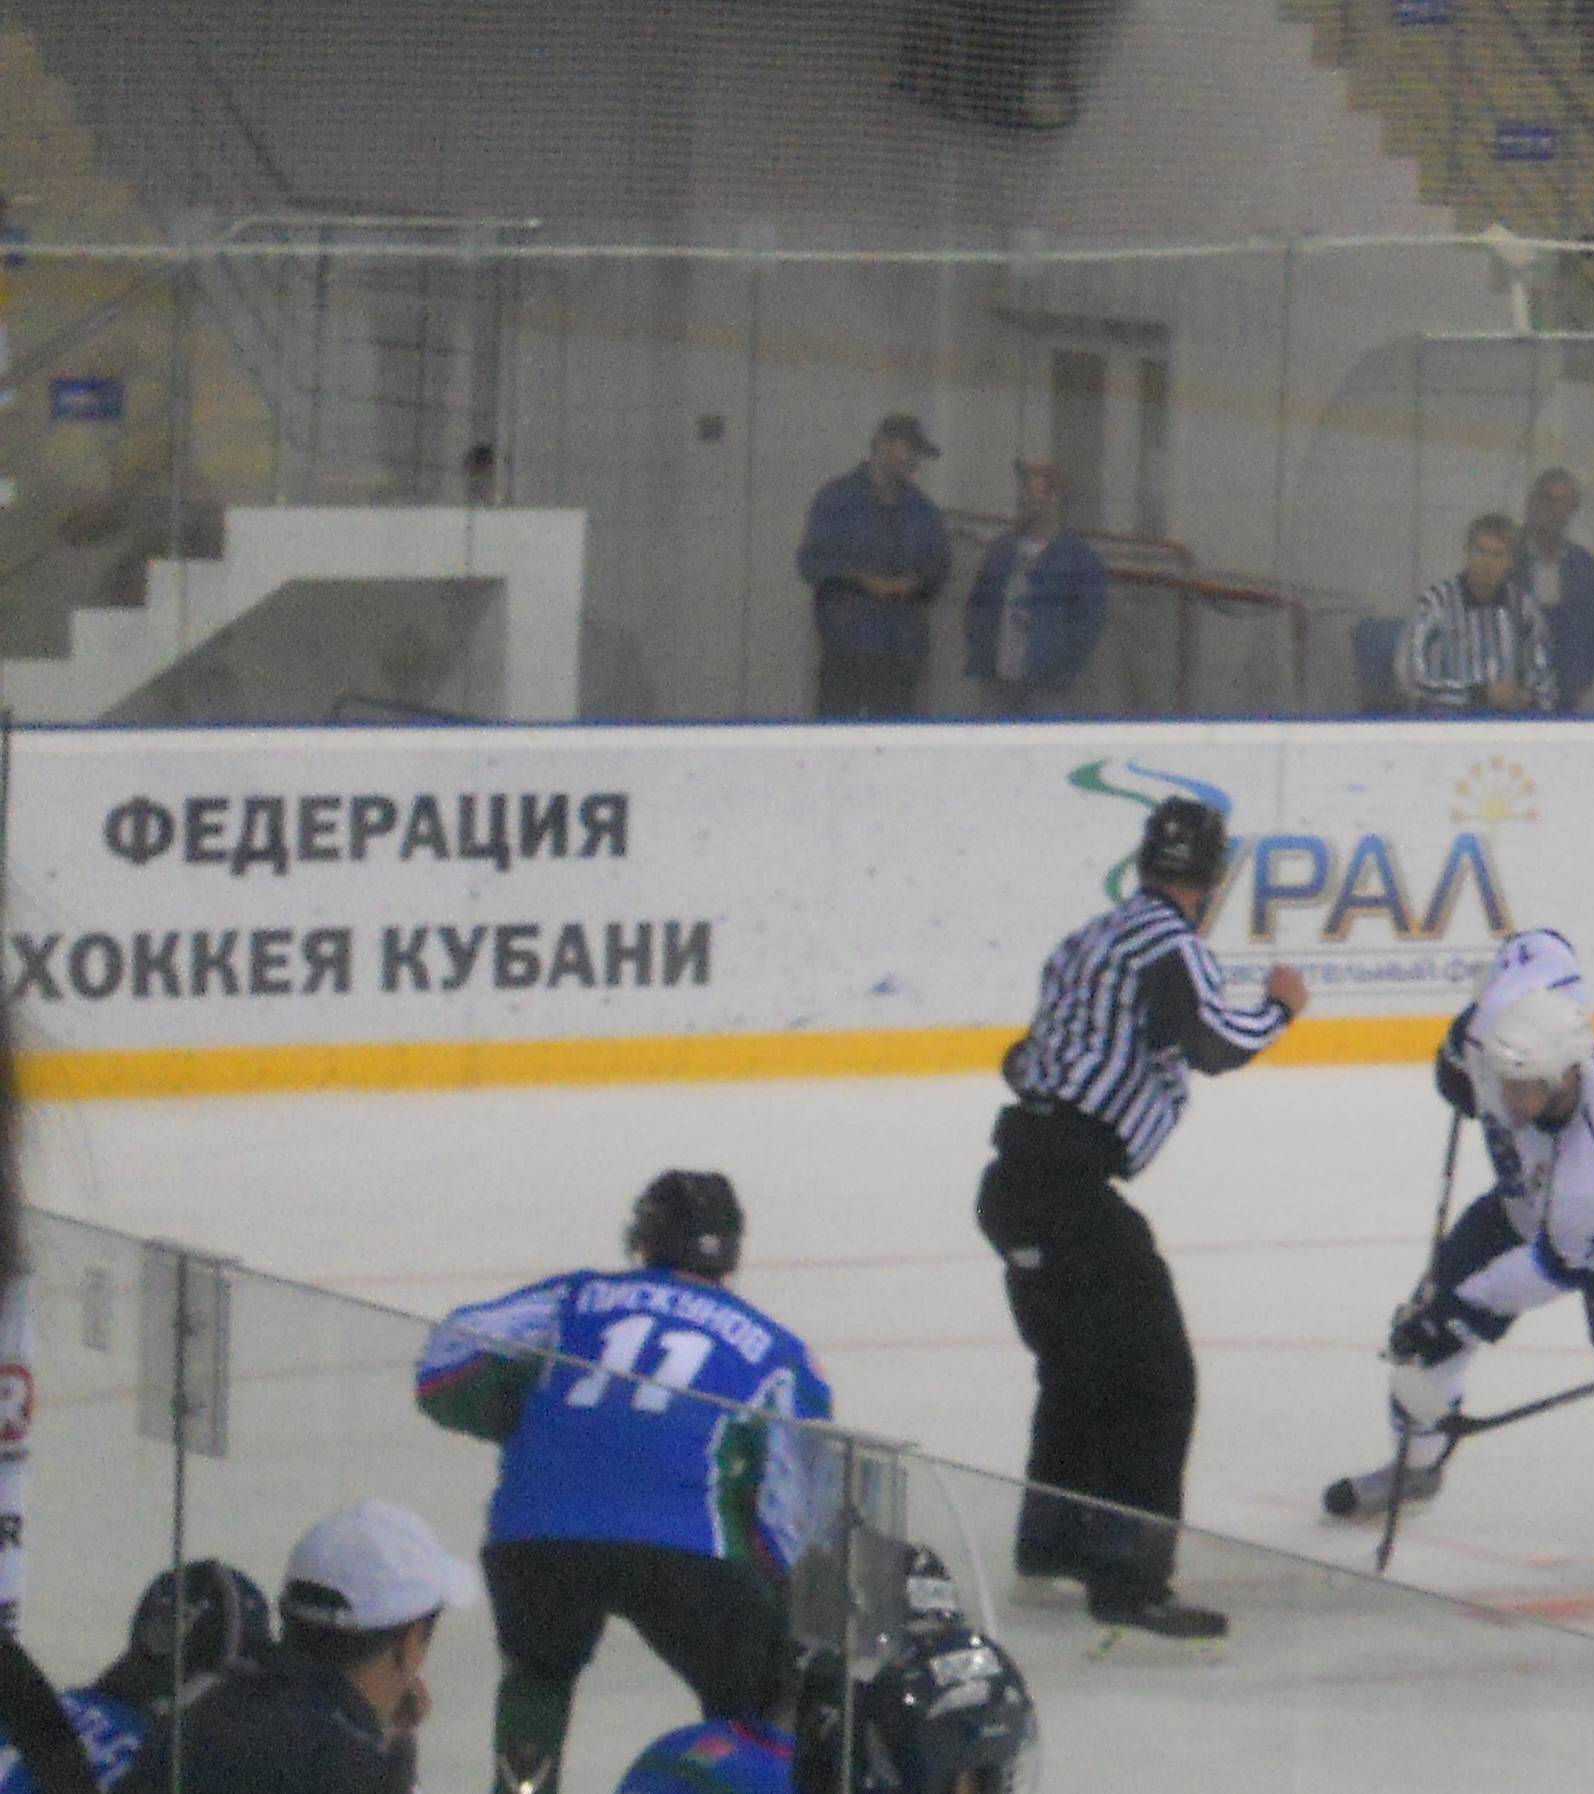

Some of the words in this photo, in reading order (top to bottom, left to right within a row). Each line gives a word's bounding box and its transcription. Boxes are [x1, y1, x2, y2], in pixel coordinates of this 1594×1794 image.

[104, 792, 630, 878] ФЕДЕРАЦИЯ
[1200, 832, 1513, 941] РАЛ
[9, 927, 353, 1001] ХОККЕЯ
[380, 920, 712, 993] КУБАНИ
[565, 1314, 716, 1413] 11
